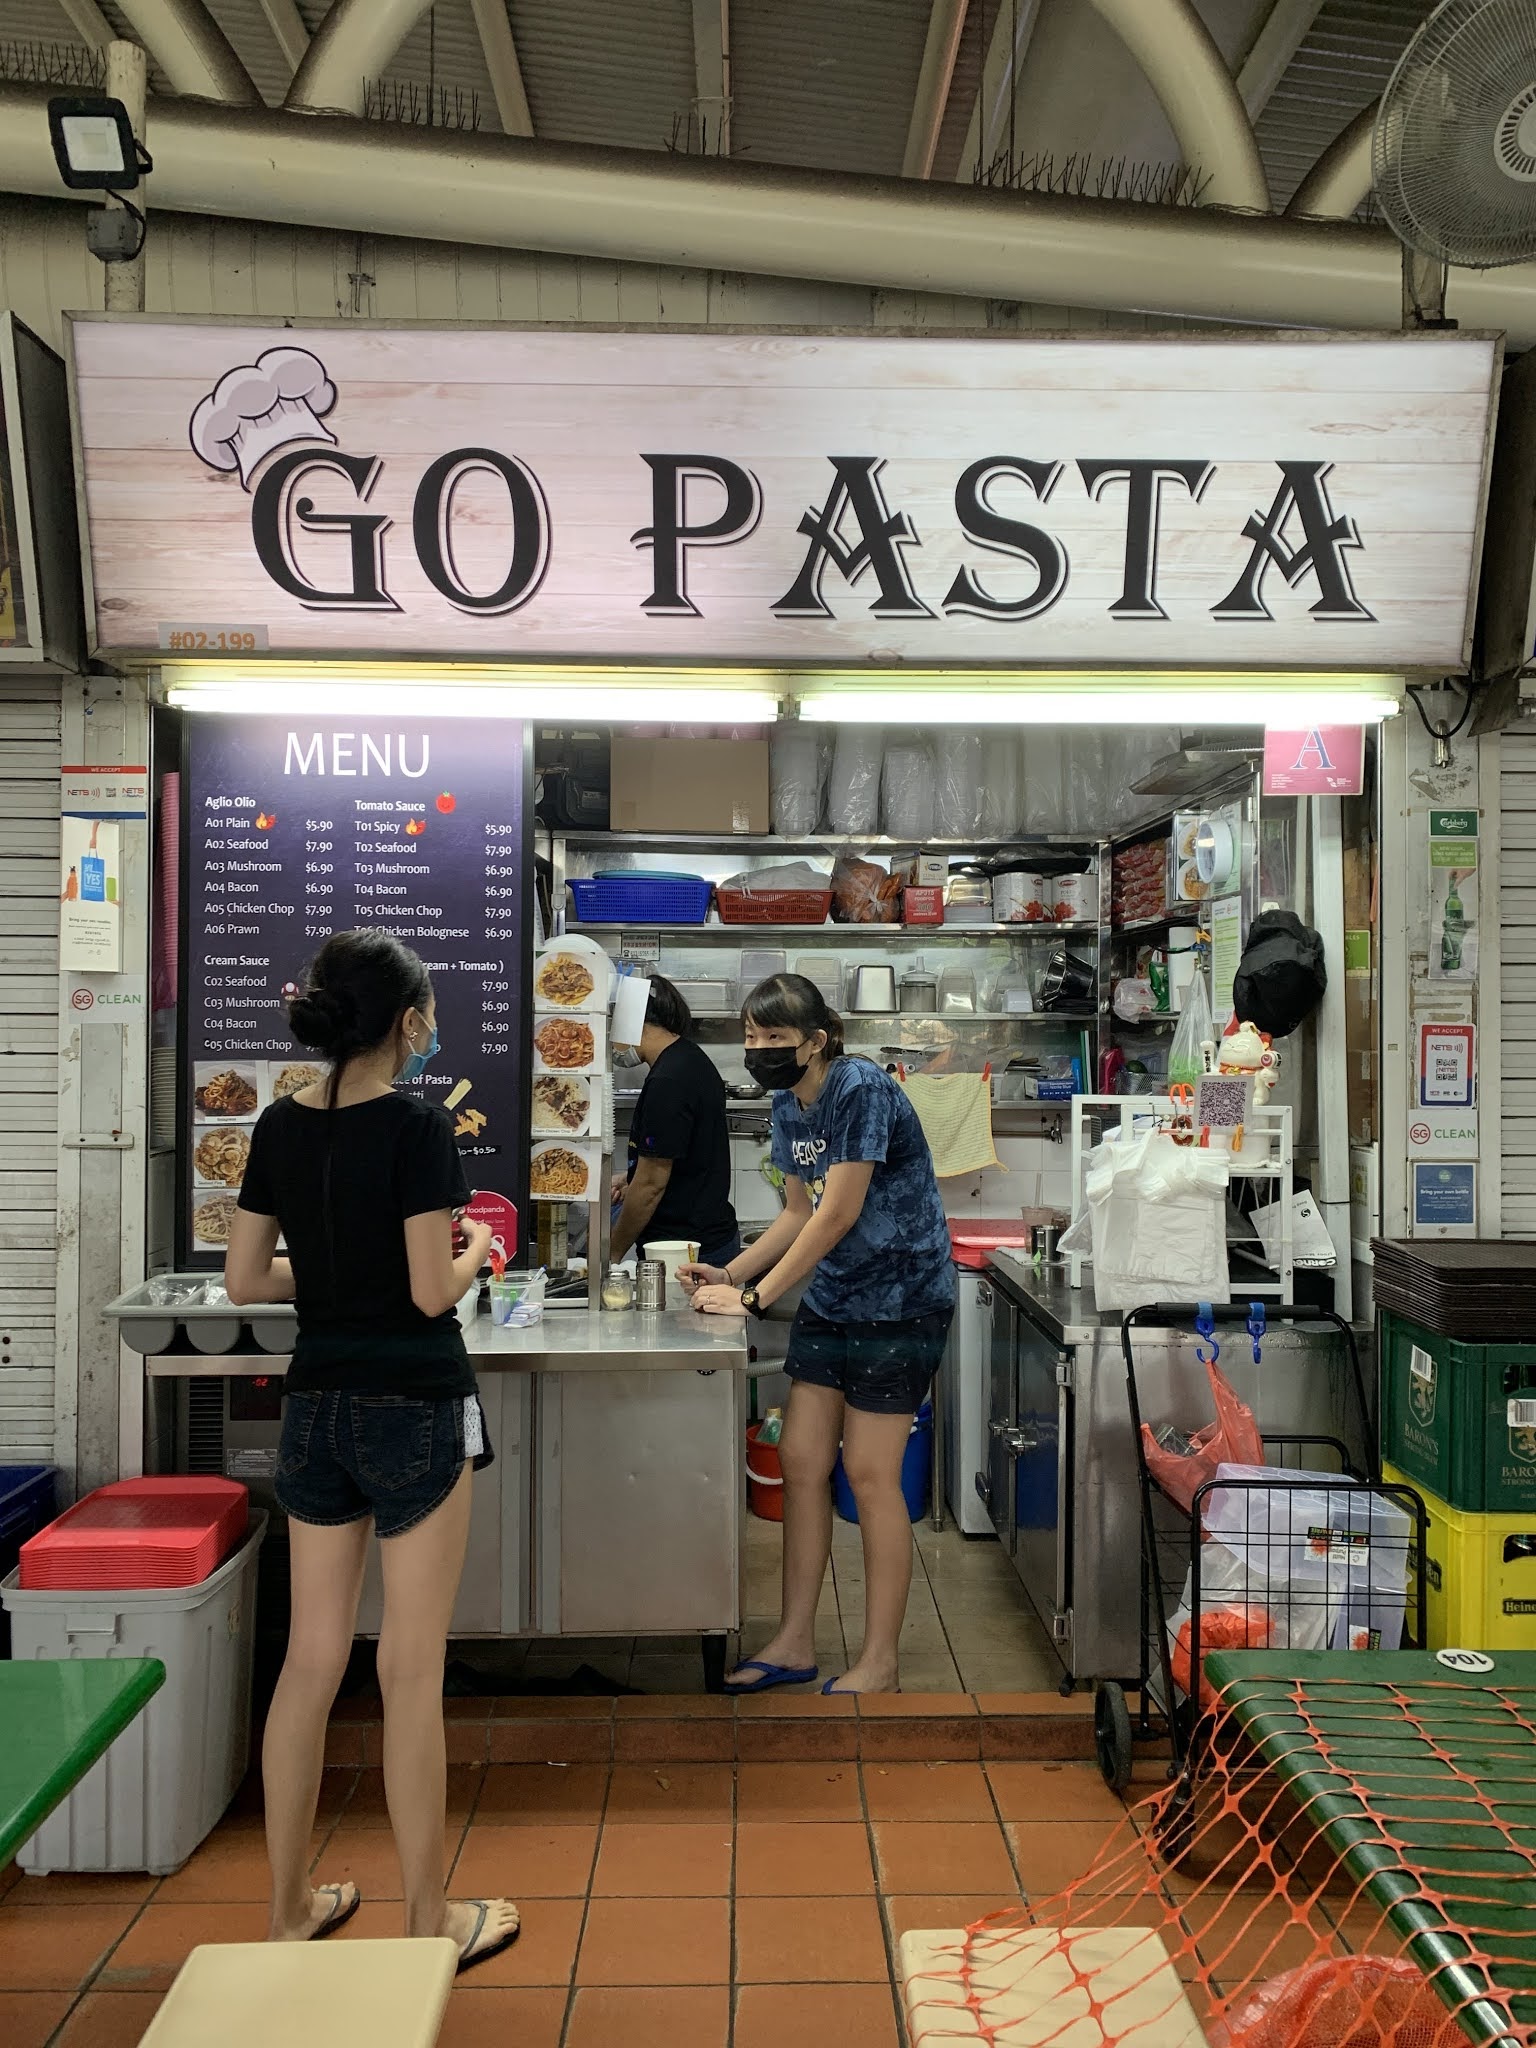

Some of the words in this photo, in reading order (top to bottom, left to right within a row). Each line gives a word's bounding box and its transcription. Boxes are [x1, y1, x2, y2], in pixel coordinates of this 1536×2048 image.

[251, 447, 551, 617] GO
[630, 453, 1378, 623] PASTA
[169, 631, 255, 650] #02-199
[283, 732, 430, 777] MENU
[1289, 727, 1337, 770] A
[205, 796, 232, 808] Aglio
[235, 796, 256, 808] Olio
[354, 800, 394, 811] Tomato
[396, 801, 426, 812] Sauce
[204, 817, 224, 828] A01
[226, 817, 250, 828] Plain
[305, 819, 333, 832] $5.90
[354, 821, 372, 831] T01
[374, 821, 400, 835] Spicy
[485, 823, 512, 836] $5.90
[1440, 817, 1468, 829] Carlsberg
[204, 839, 224, 849] A02
[227, 838, 269, 850] Seafood
[305, 840, 333, 853] $7.90
[354, 842, 373, 852] T02
[375, 842, 417, 853] Seafood
[485, 844, 512, 857] $7.90
[204, 861, 225, 874] A03
[227, 860, 282, 872] Mushroom
[305, 861, 334, 874] $6.90
[354, 863, 373, 875] T03
[375, 863, 430, 874] Mushroom
[485, 865, 513, 877] $6.90
[86, 873, 101, 886] YES
[204, 882, 225, 894] A04
[227, 881, 259, 892] Bacon
[305, 882, 333, 895] $6.90
[354, 884, 373, 896] T04
[375, 884, 407, 895] Bacon
[485, 885, 513, 898] $6.90
[204, 903, 224, 916] A05
[227, 903, 266, 914] Chicken
[268, 903, 294, 917] Chop
[305, 903, 332, 916] $7.90
[354, 905, 373, 917] T05
[375, 905, 414, 916] Chicken
[416, 905, 443, 918] Chop
[485, 906, 512, 919] $7.90
[204, 924, 224, 934] A06
[227, 924, 260, 935] Prawn
[305, 925, 332, 937] $7.90
[417, 926, 469, 939] Bolognese
[485, 927, 513, 939] $6.90
[204, 955, 238, 966] Cream
[239, 955, 270, 966] Sauce
[420, 960, 448, 971] ream
[458, 960, 497, 971] Tomato
[204, 977, 223, 987] C02
[225, 976, 267, 987] Seafood
[481, 980, 509, 992] $7.90
[75, 994, 91, 1004] SG
[97, 994, 141, 1004] CLEAN
[204, 998, 224, 1010] C03
[226, 997, 280, 1008] Mushroom
[481, 1000, 509, 1013] $6.90
[204, 1019, 224, 1031] C04
[226, 1018, 257, 1029] Bacon
[481, 1021, 509, 1034] $6.90
[224, 1038, 264, 1050] Chicken
[265, 1038, 292, 1052] Chop
[481, 1042, 508, 1054] $7.90
[411, 1073, 424, 1085] of
[425, 1074, 453, 1085] Pasta
[1413, 1129, 1428, 1139] SG
[1434, 1129, 1476, 1139] CLEAN
[467, 1206, 506, 1215] foodpanda
[1441, 1654, 1487, 1665] 104
